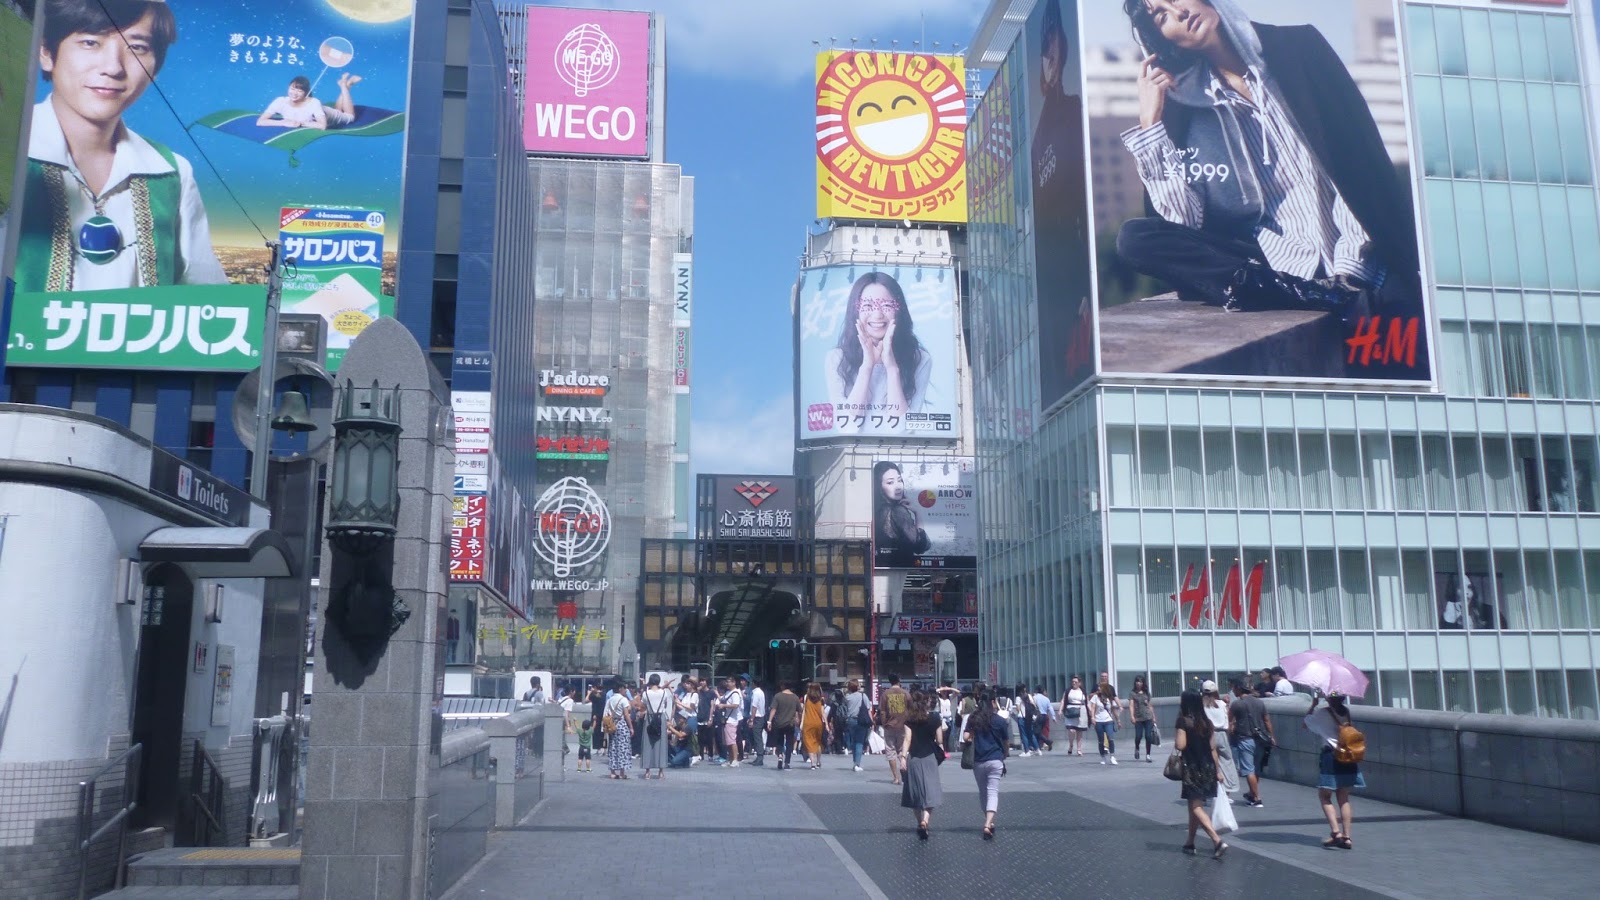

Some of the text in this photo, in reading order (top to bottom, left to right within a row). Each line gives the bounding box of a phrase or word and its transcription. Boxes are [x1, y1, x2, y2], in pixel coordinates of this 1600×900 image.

[229, 33, 305, 50] 夢のような、
[229, 50, 304, 66] きもちよさ。
[817, 52, 947, 111] NICONICO
[535, 103, 636, 141] WEGO
[832, 127, 966, 193] RENTACAR
[1162, 145, 1199, 160] シャツ
[1163, 161, 1229, 184] ¥1,999
[820, 176, 965, 217] ニコニコレンタカー
[368, 215, 381, 224] 40
[284, 237, 378, 263] サロンパス
[677, 267, 689, 313] NYNY
[43, 300, 252, 356] サロンパス
[1344, 314, 1419, 368] H&M
[540, 369, 609, 387] J'adore
[836, 403, 900, 411] 運命の出会いアプリ
[837, 415, 900, 429] ワクワク
[194, 477, 229, 514] Toilets
[938, 489, 972, 499] ARROW
[720, 509, 792, 528] 心斎橋筋
[466, 496, 483, 571] インターネット
[1169, 562, 1265, 630] H&M
